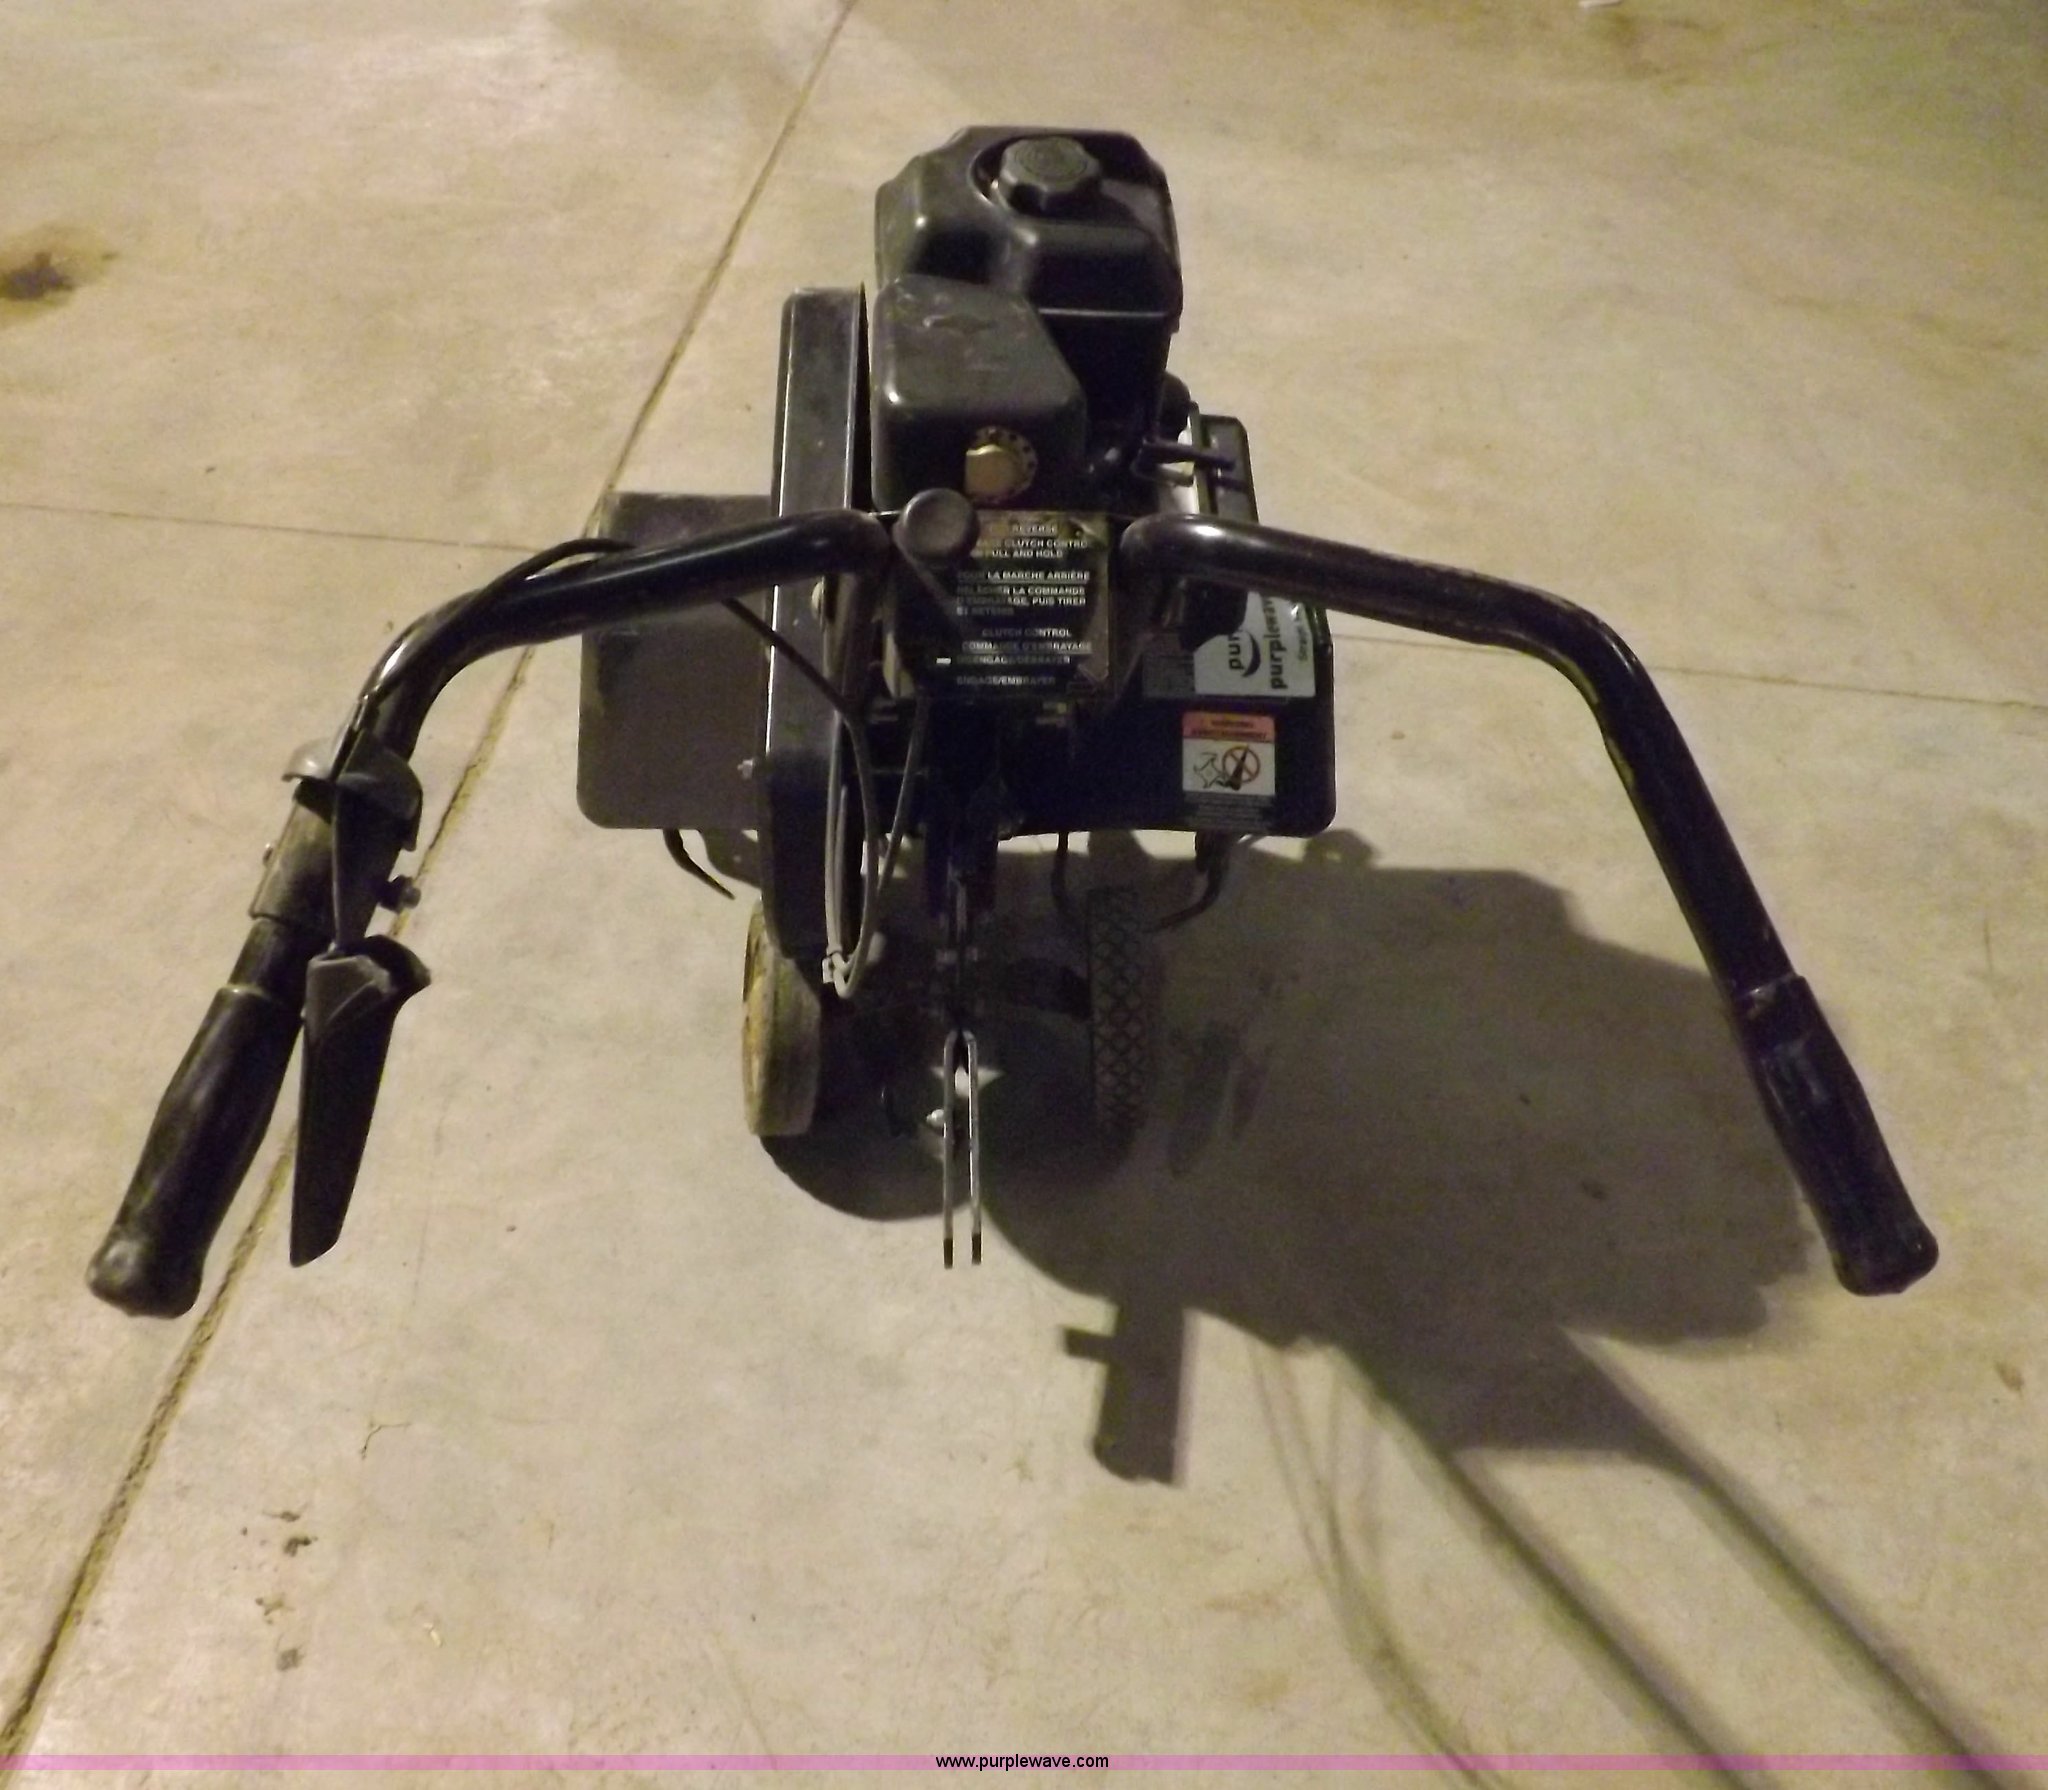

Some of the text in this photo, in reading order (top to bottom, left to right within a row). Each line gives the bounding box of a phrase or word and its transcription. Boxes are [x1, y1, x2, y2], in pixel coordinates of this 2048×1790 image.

[987, 571, 1000, 580] LA
[1024, 628, 1071, 637] CONTROL
[1263, 599, 1288, 690] purplewav
